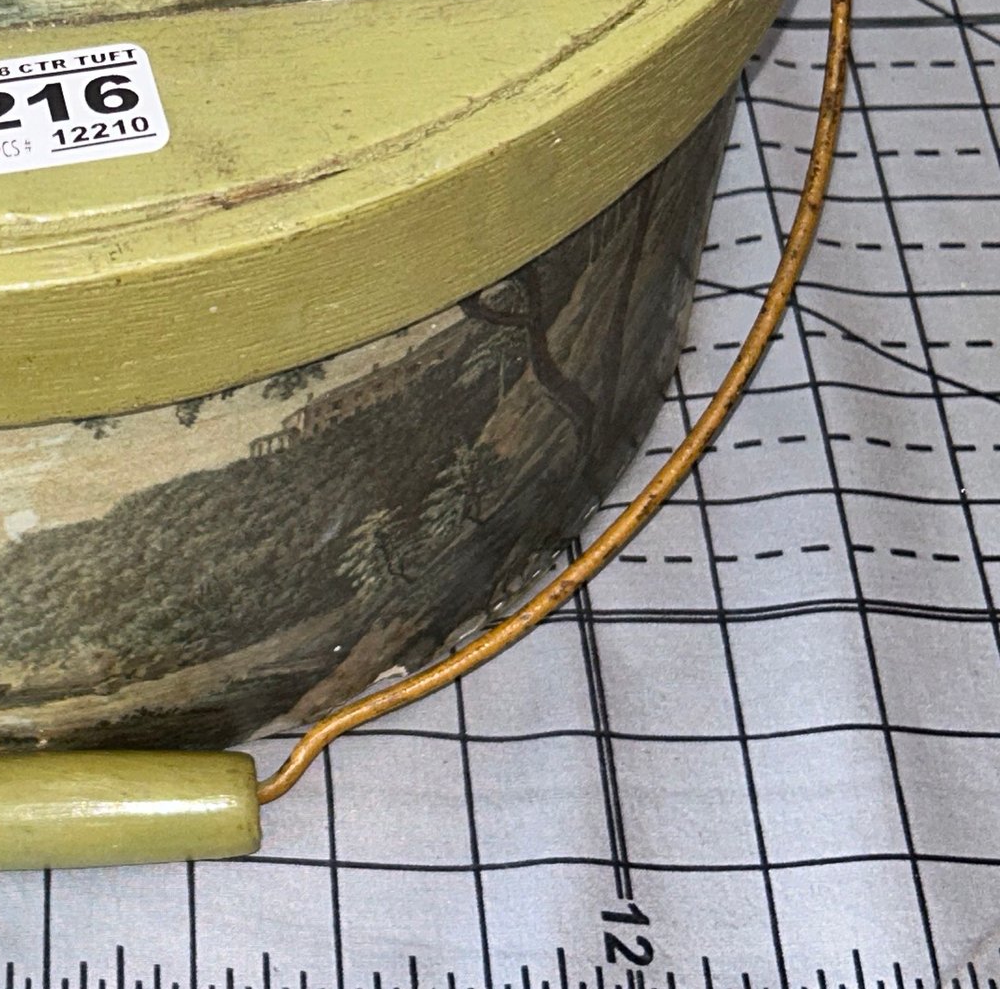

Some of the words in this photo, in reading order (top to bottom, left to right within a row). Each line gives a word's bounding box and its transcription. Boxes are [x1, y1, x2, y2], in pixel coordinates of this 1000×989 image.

[18, 59, 67, 74] CTR
[73, 48, 137, 66] TUFT
[51, 116, 149, 146] 12210
[601, 902, 654, 966] 12
